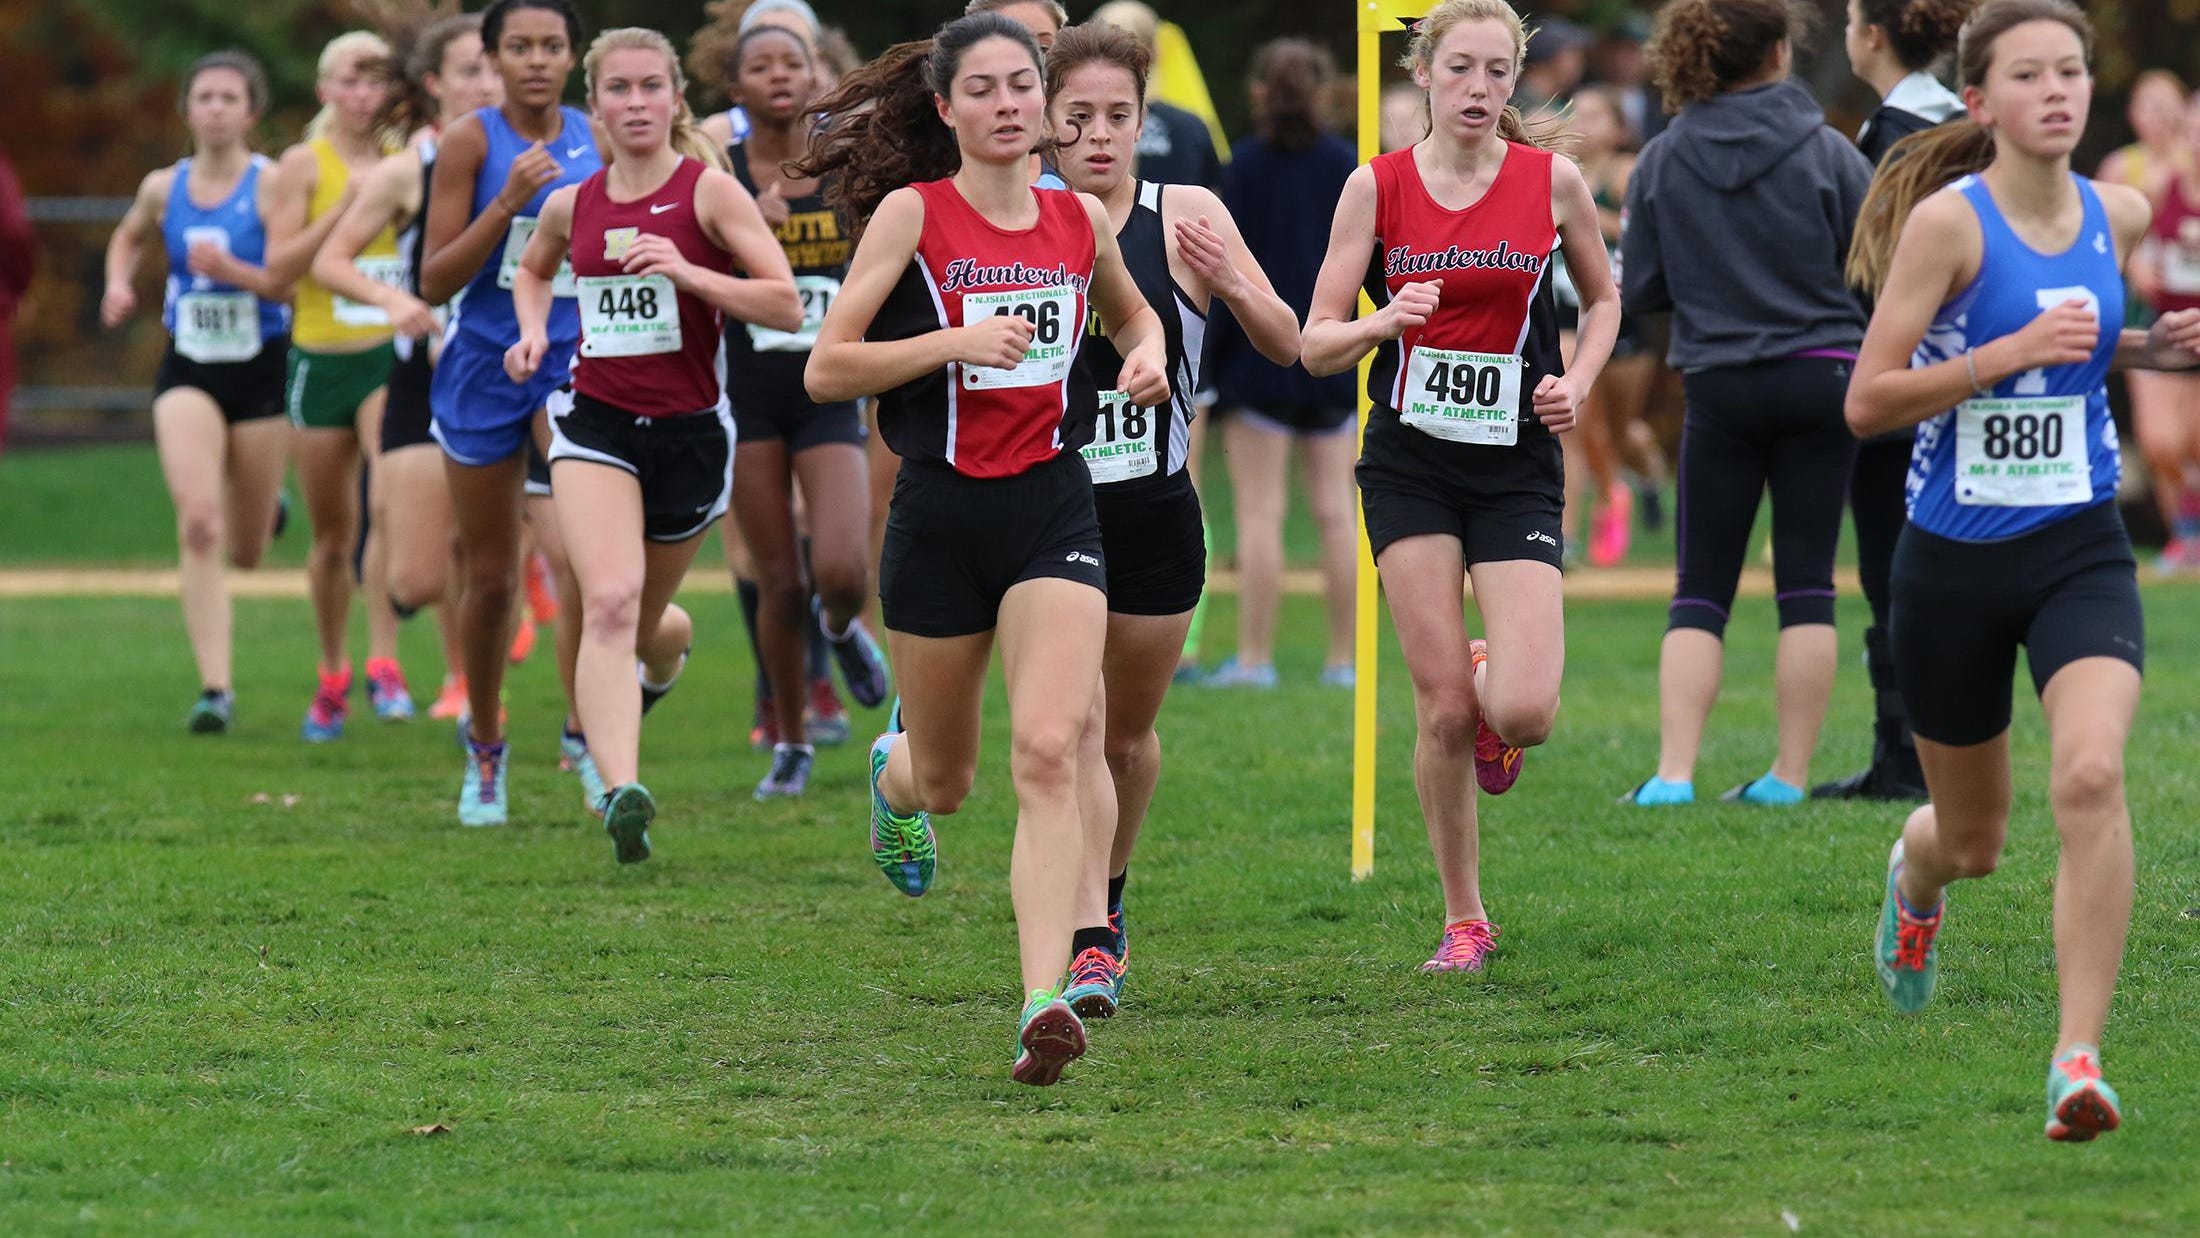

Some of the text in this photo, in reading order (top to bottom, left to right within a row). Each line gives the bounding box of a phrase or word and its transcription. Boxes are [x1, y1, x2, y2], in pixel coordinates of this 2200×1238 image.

[1385, 240, 1540, 277] Hunterdon
[941, 258, 1085, 296] Hunterdon
[599, 287, 658, 320] 448
[975, 288, 1068, 304] NJSIAA SECTIONALS
[1023, 345, 1065, 360] HLETIC
[1418, 349, 1513, 364] NJSIAA SECTIONALS
[1425, 362, 1501, 407] 490
[1412, 402, 1508, 421] M-F ATHLETIC
[1984, 413, 2062, 460] 880
[1082, 441, 1147, 459] ATHLETIC
